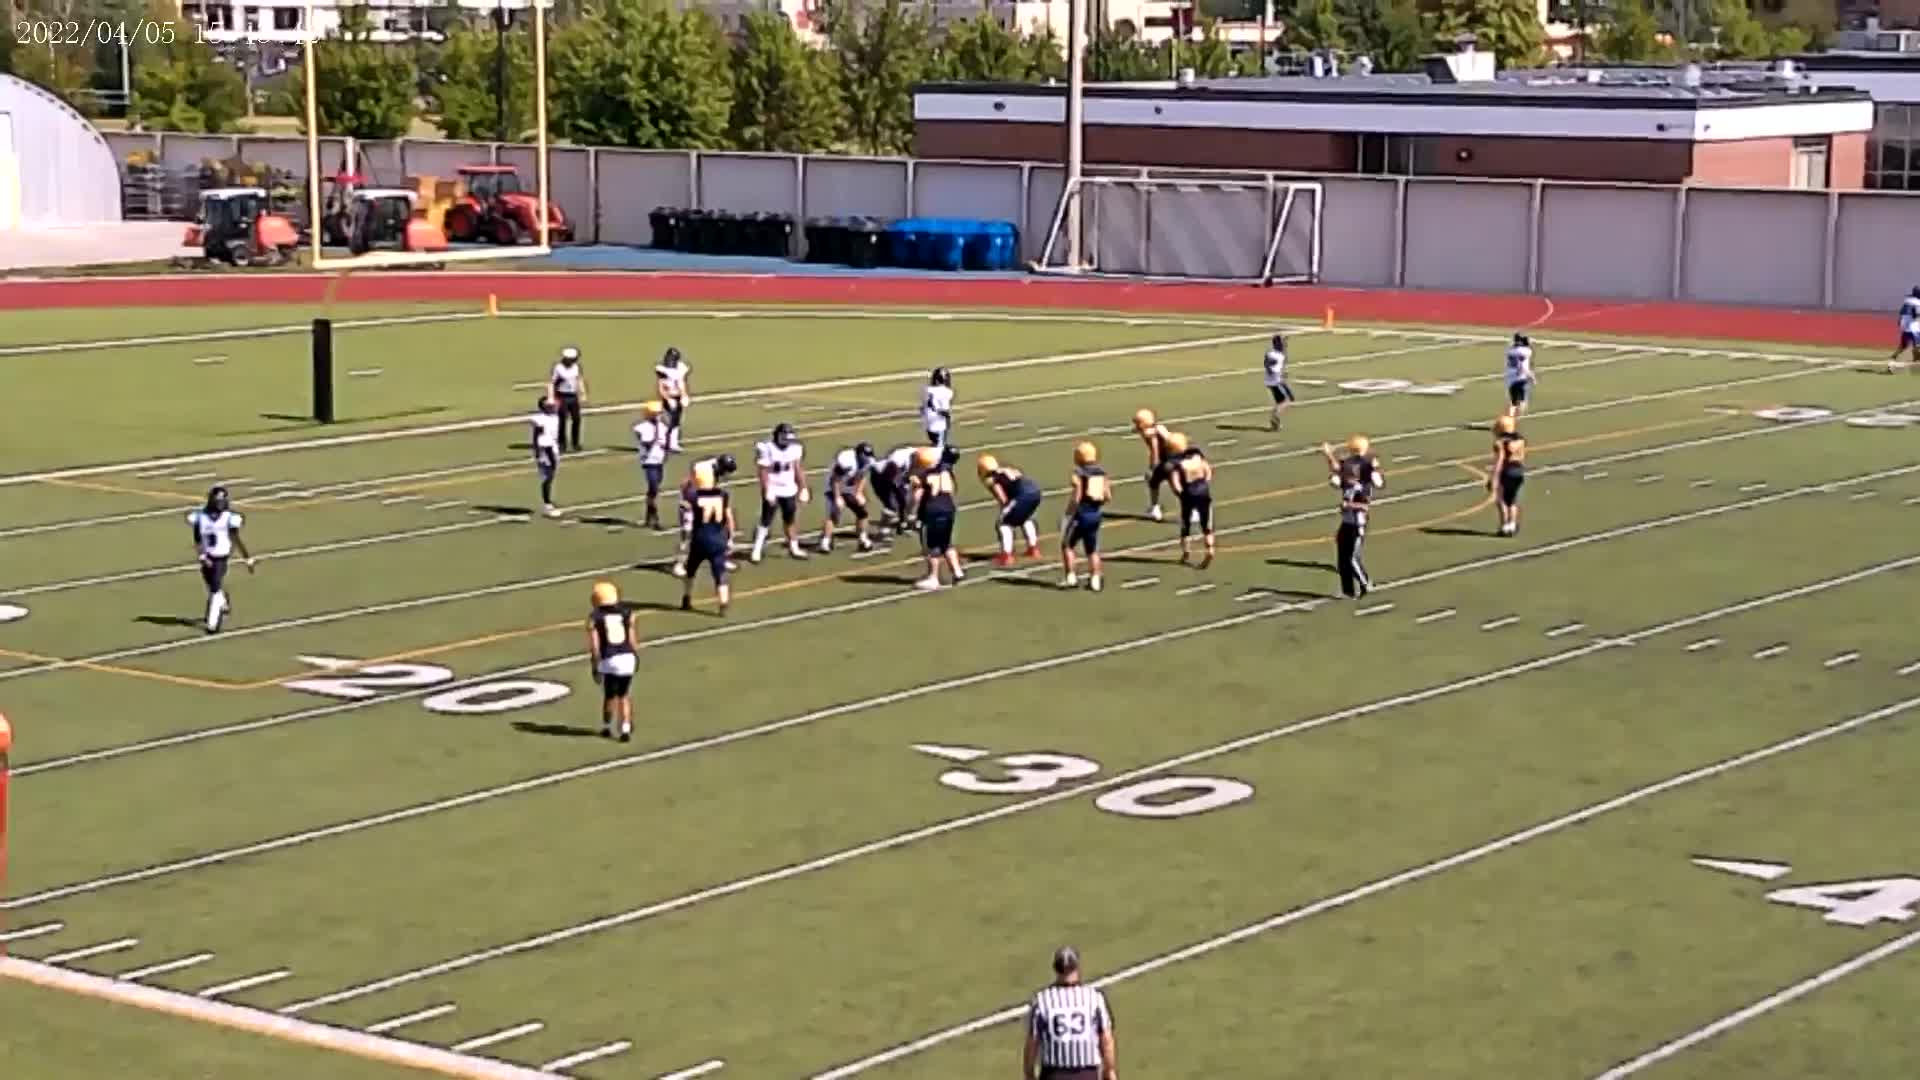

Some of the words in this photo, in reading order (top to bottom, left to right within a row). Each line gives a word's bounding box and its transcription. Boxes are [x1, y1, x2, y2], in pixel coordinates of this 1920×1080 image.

[281, 663, 571, 714] 20
[939, 752, 1256, 817] 30
[1052, 1012, 1086, 1037] 63
